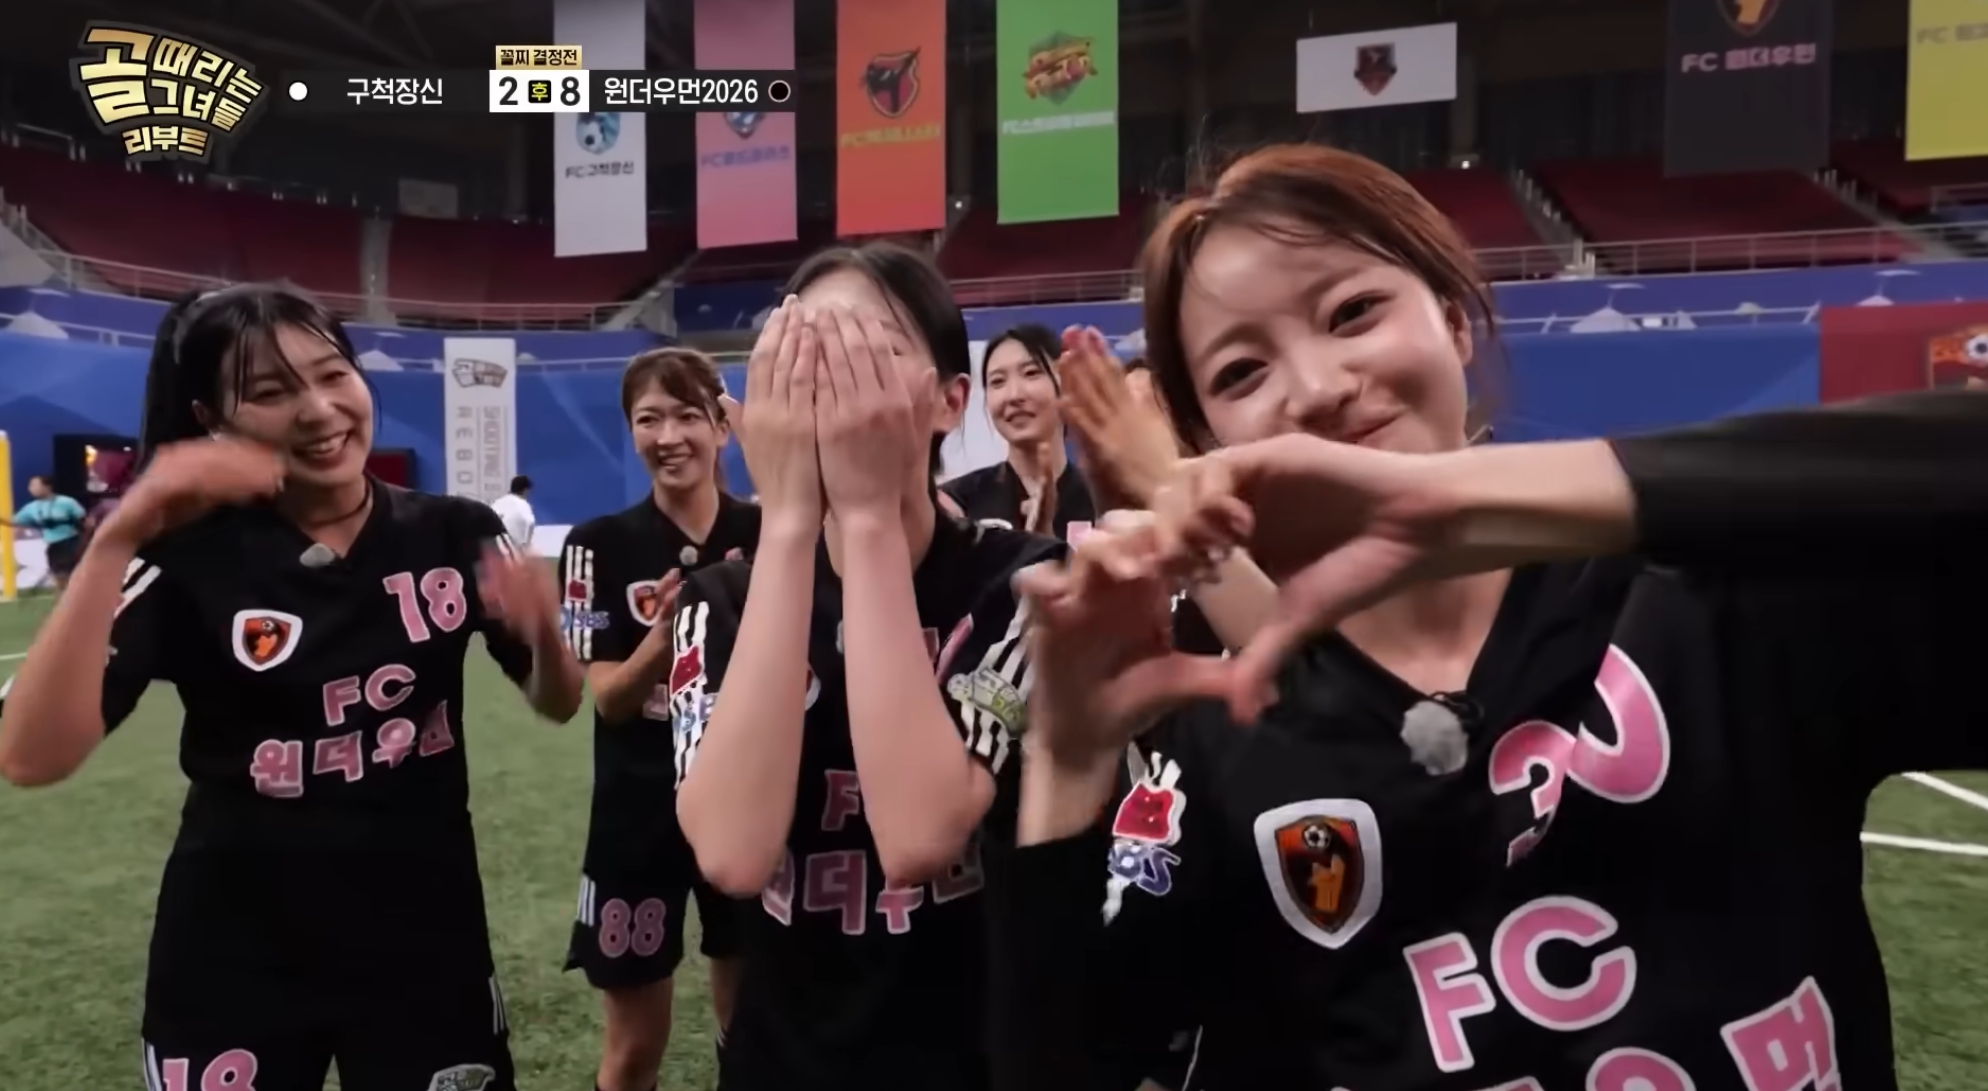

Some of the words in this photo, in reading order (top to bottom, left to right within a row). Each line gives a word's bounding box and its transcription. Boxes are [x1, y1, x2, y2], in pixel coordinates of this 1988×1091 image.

[1681, 52, 1718, 72] FC
[382, 566, 468, 643] 18
[322, 663, 417, 727] FC
[598, 896, 667, 958] 88
[1402, 896, 1637, 1073] FC
